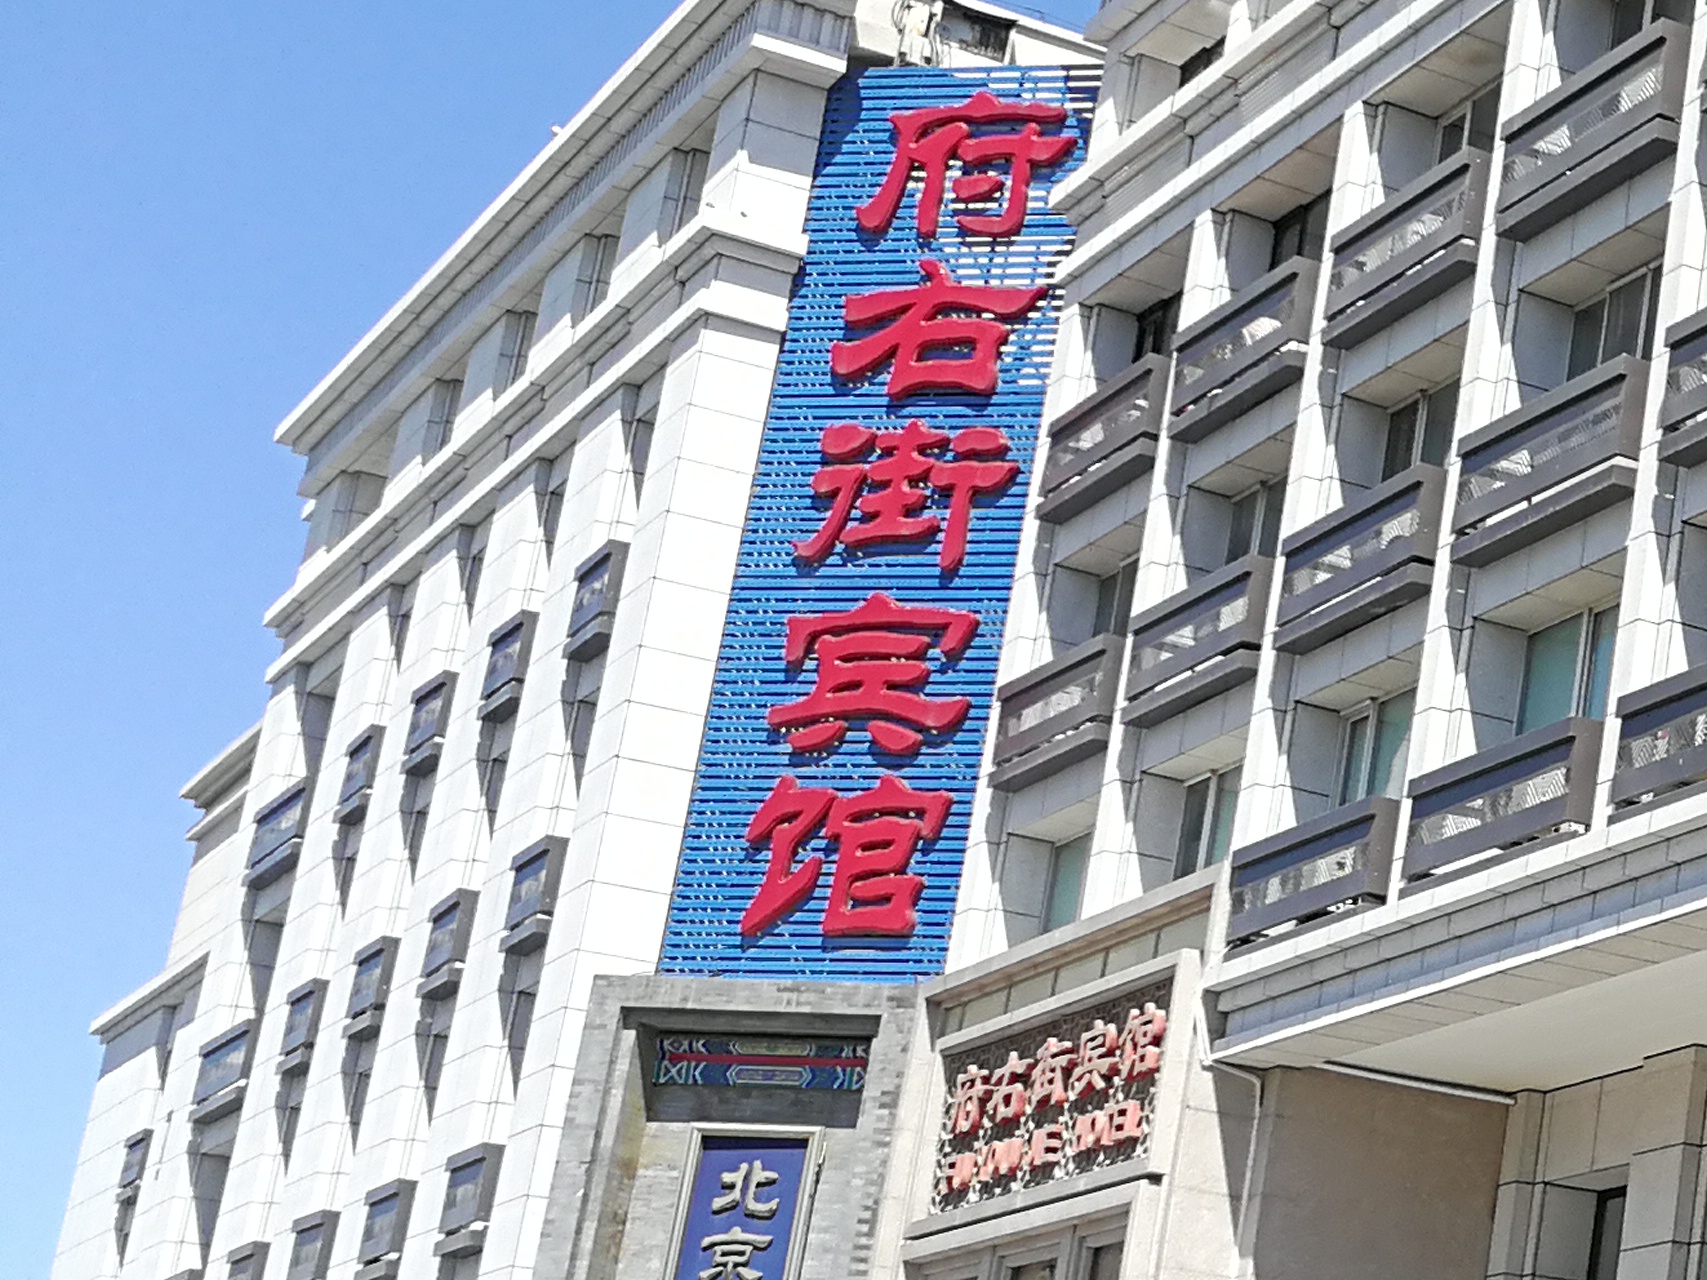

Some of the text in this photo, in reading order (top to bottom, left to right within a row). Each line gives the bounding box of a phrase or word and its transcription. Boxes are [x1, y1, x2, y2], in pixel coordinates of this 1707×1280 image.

[740, 91, 1078, 938] 府右街宾馆
[949, 1001, 1168, 1137] 府右街宾馆
